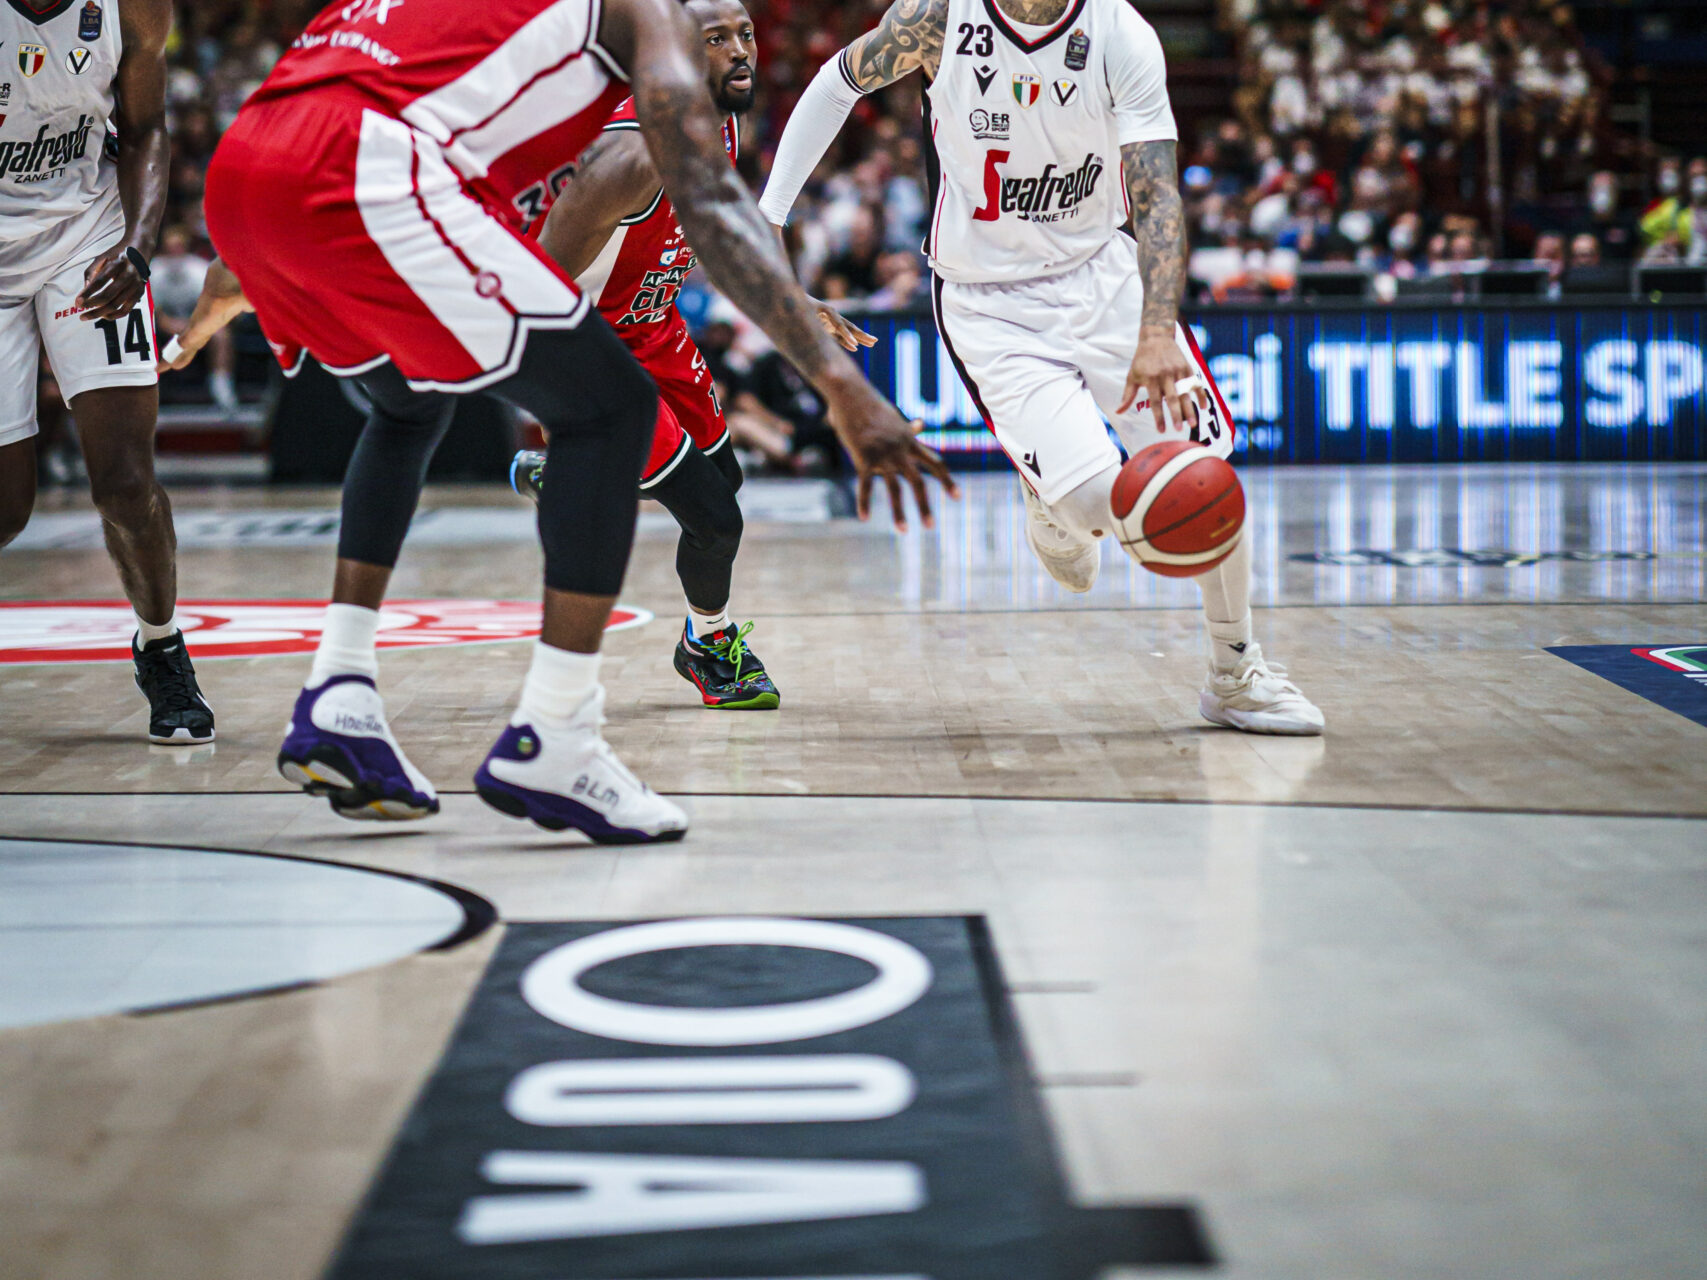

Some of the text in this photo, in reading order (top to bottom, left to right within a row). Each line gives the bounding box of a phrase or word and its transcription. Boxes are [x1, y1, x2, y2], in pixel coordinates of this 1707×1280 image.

[956, 23, 994, 57] 23
[14, 167, 66, 183] ZANETT
[1032, 206, 1079, 223] ANETTI
[94, 308, 151, 366] 14
[1308, 340, 1563, 431] TITLE
